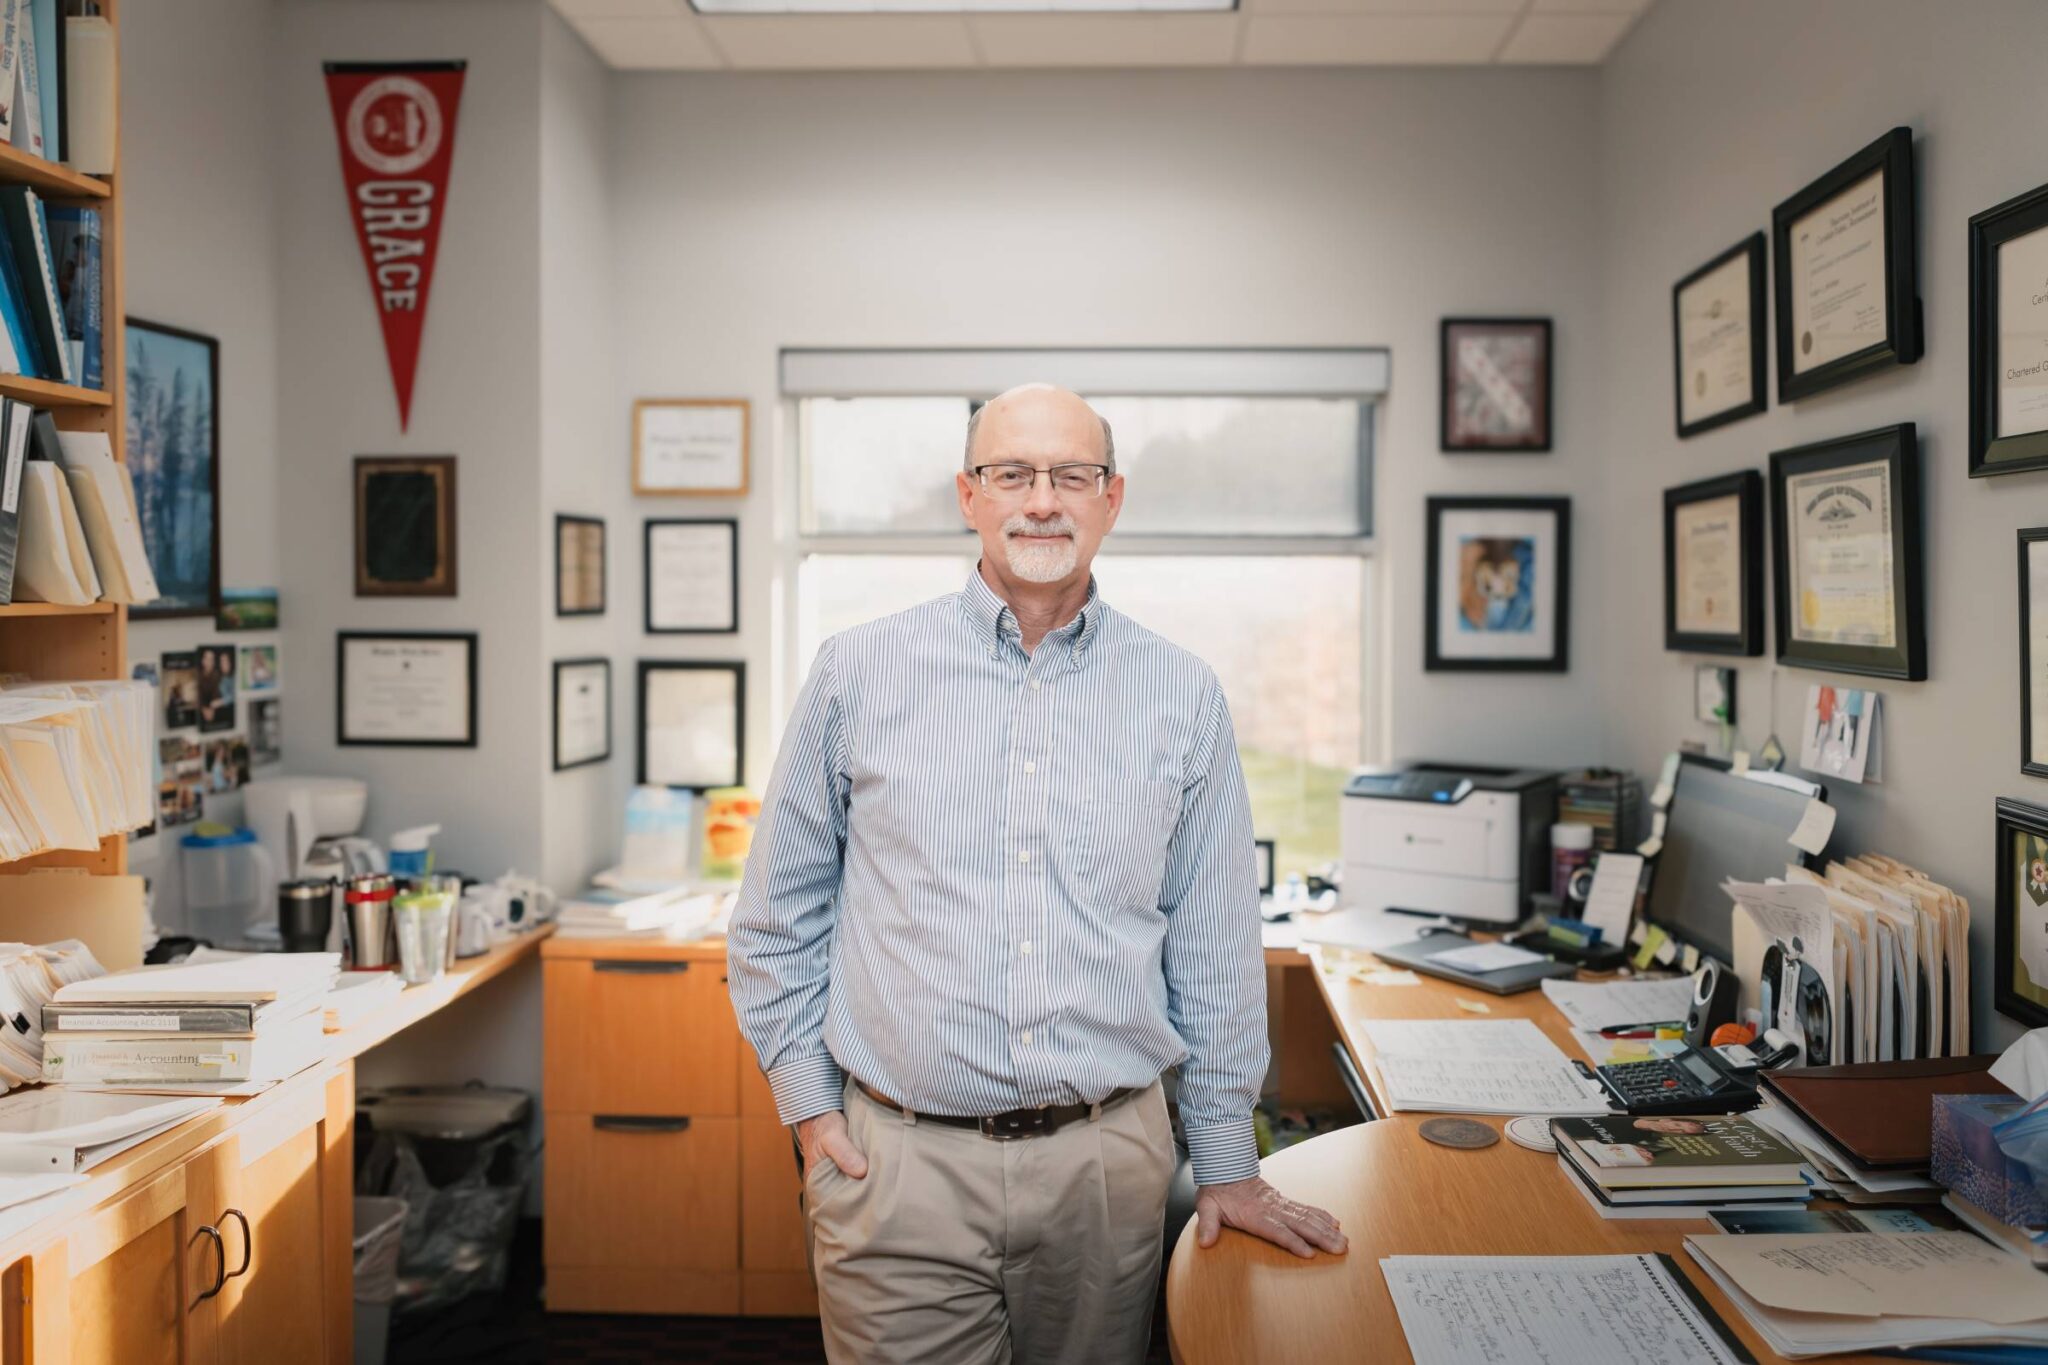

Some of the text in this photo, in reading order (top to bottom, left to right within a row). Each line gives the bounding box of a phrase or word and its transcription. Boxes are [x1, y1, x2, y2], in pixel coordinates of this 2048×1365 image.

[357, 180, 434, 311] GRACE
[2007, 362, 2040, 379] Chartered
[134, 1053, 201, 1067] Accounting
[1732, 1125, 1767, 1143] Cost
[1719, 1135, 1762, 1157] Faith
